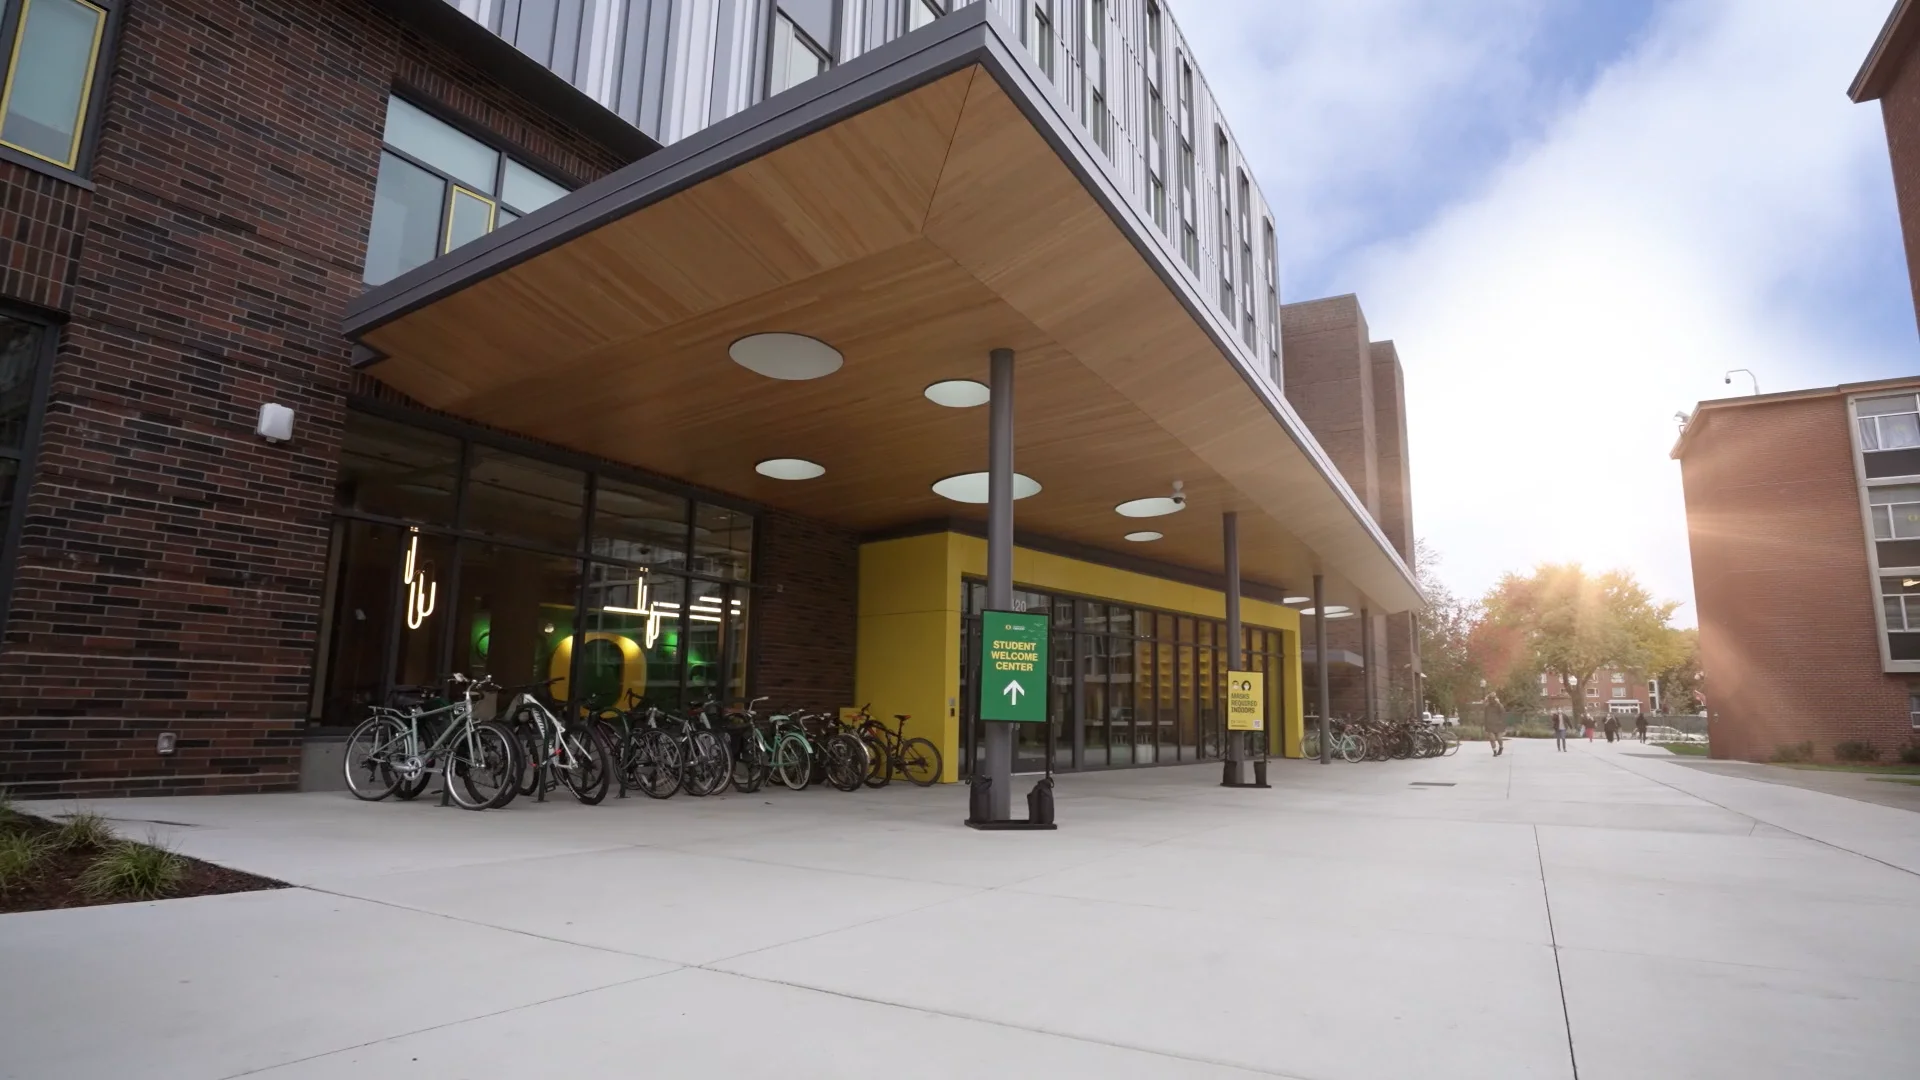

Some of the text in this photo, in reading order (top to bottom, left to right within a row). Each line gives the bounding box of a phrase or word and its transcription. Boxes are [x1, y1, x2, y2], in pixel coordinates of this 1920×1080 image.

[993, 640, 1036, 651] STUDENT
[991, 650, 1038, 661] WELCOME
[995, 661, 1033, 671] CENTER
